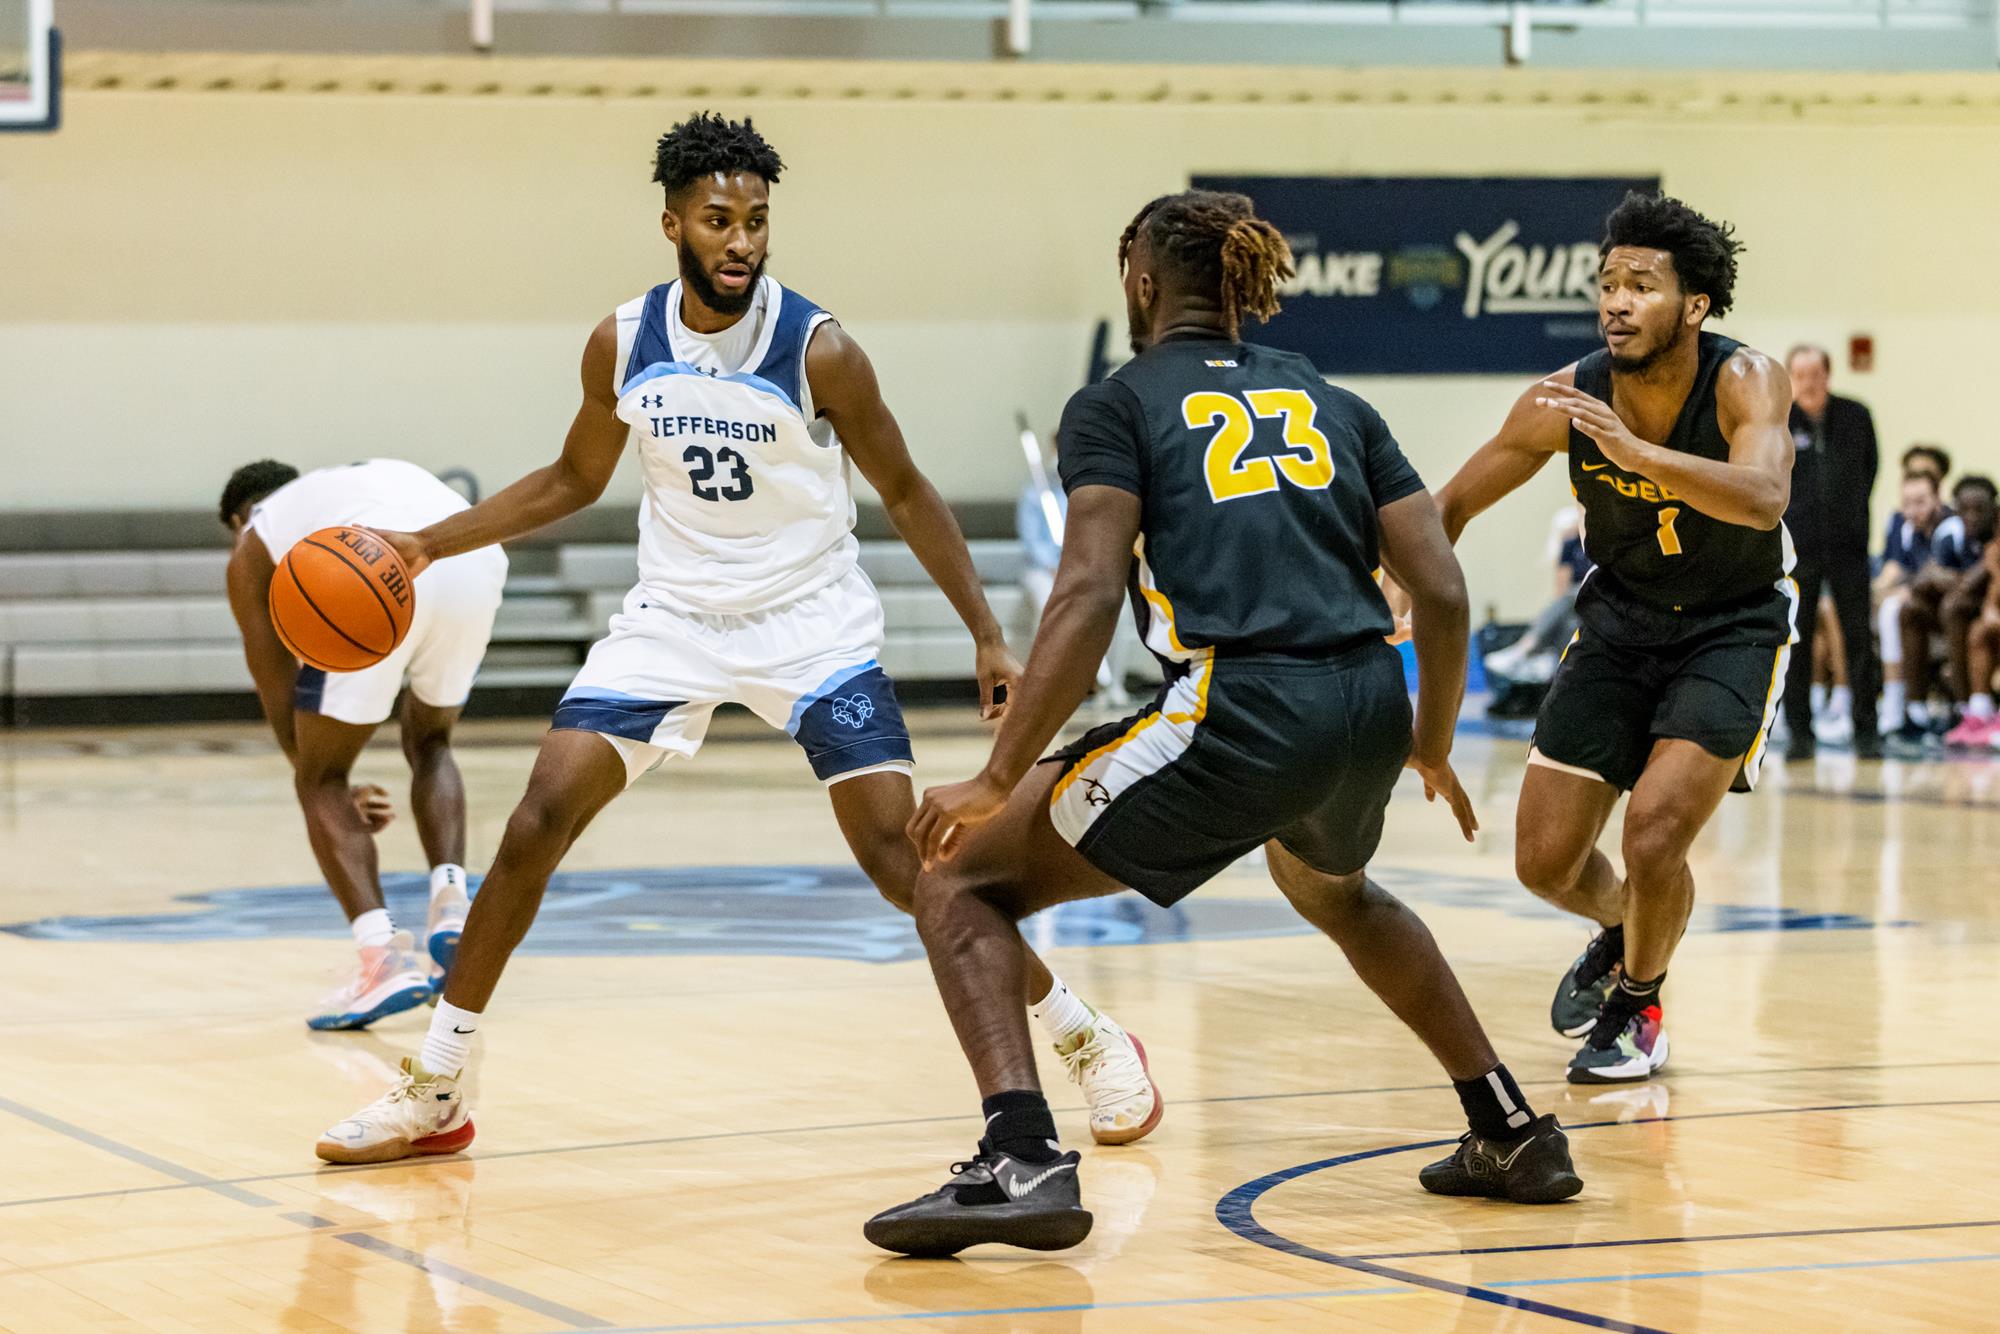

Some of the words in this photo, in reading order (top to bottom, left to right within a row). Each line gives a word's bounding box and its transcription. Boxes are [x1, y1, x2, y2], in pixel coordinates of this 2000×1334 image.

[650, 415, 777, 443] JEFFERSON
[1181, 388, 1336, 504] 23
[683, 445, 754, 502] 23
[334, 530, 385, 567] ROCK
[1656, 506, 1683, 556] 1
[378, 564, 410, 609] THE
